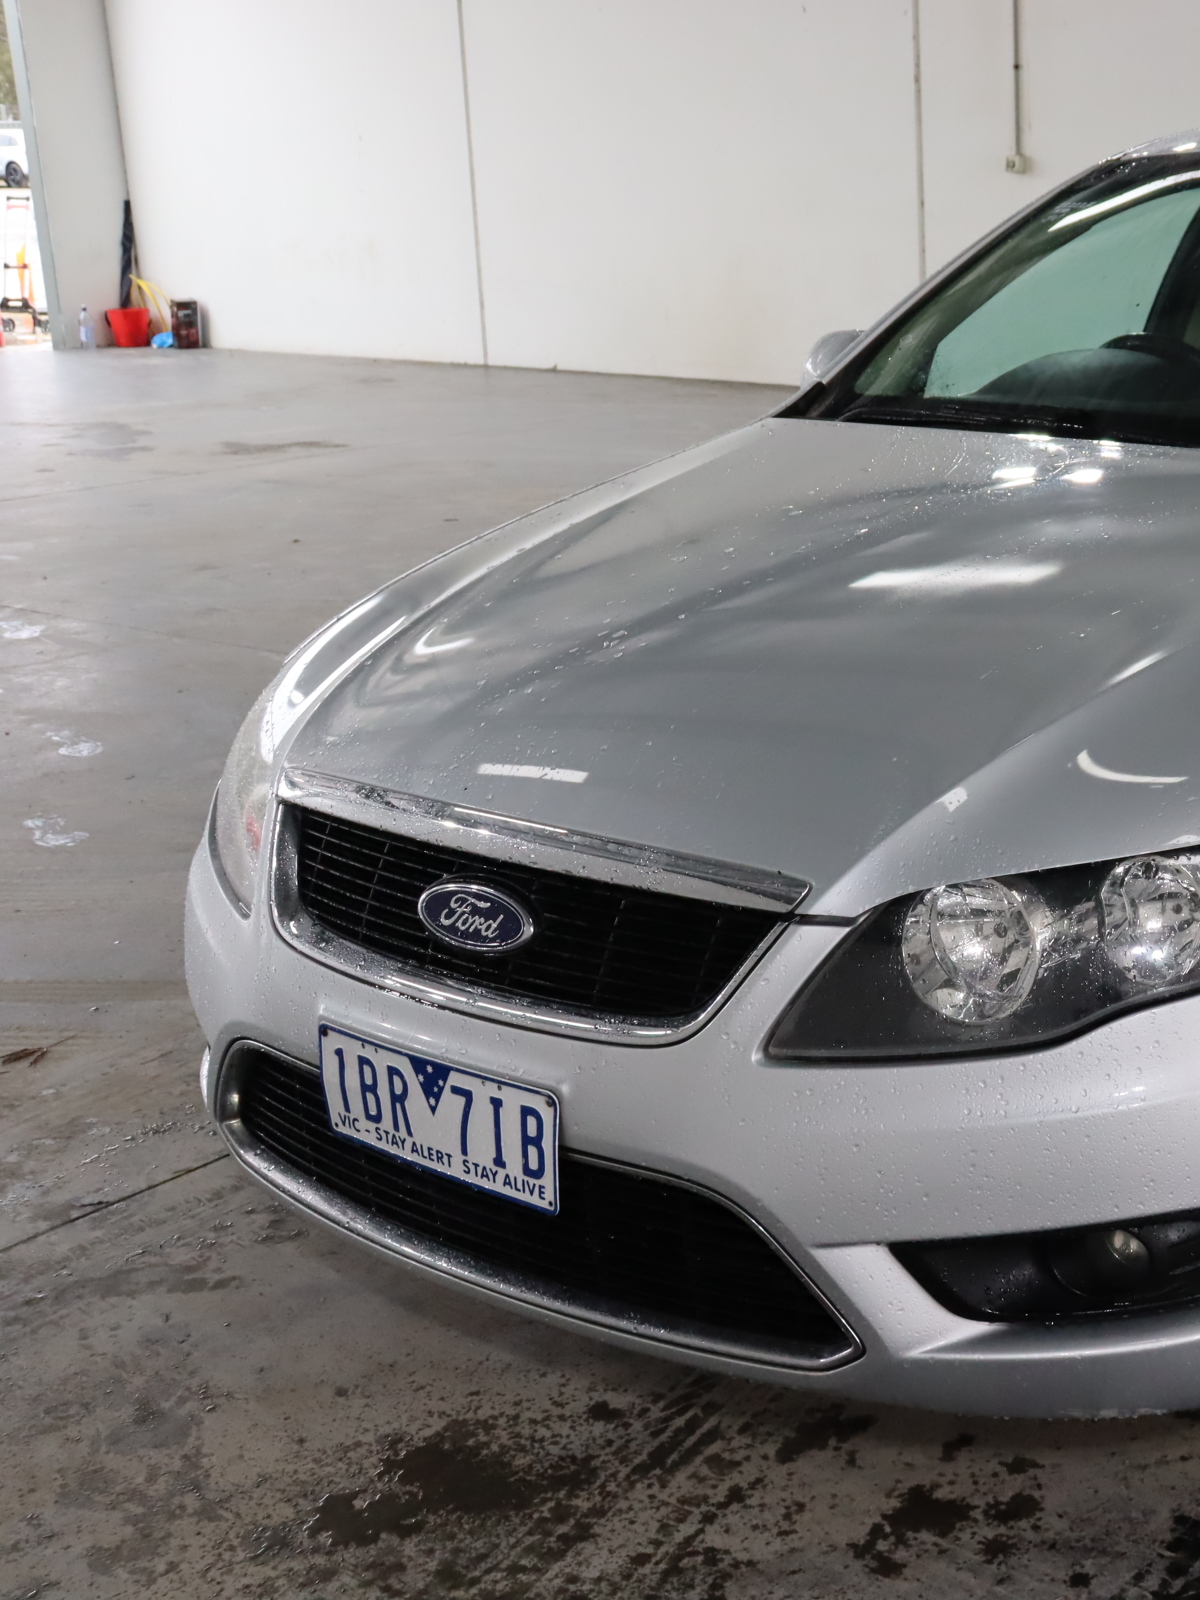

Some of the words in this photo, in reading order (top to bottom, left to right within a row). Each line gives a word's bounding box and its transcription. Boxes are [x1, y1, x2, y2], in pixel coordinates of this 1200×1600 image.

[440, 893, 504, 938] Ford
[334, 1047, 414, 1138] 1BR
[450, 1084, 546, 1180] 7IB
[338, 1112, 360, 1133] VIC
[375, 1126, 407, 1151] STAY
[411, 1141, 453, 1168] ALERT
[463, 1159, 498, 1184] STAY
[503, 1173, 547, 1201] ALIVE
